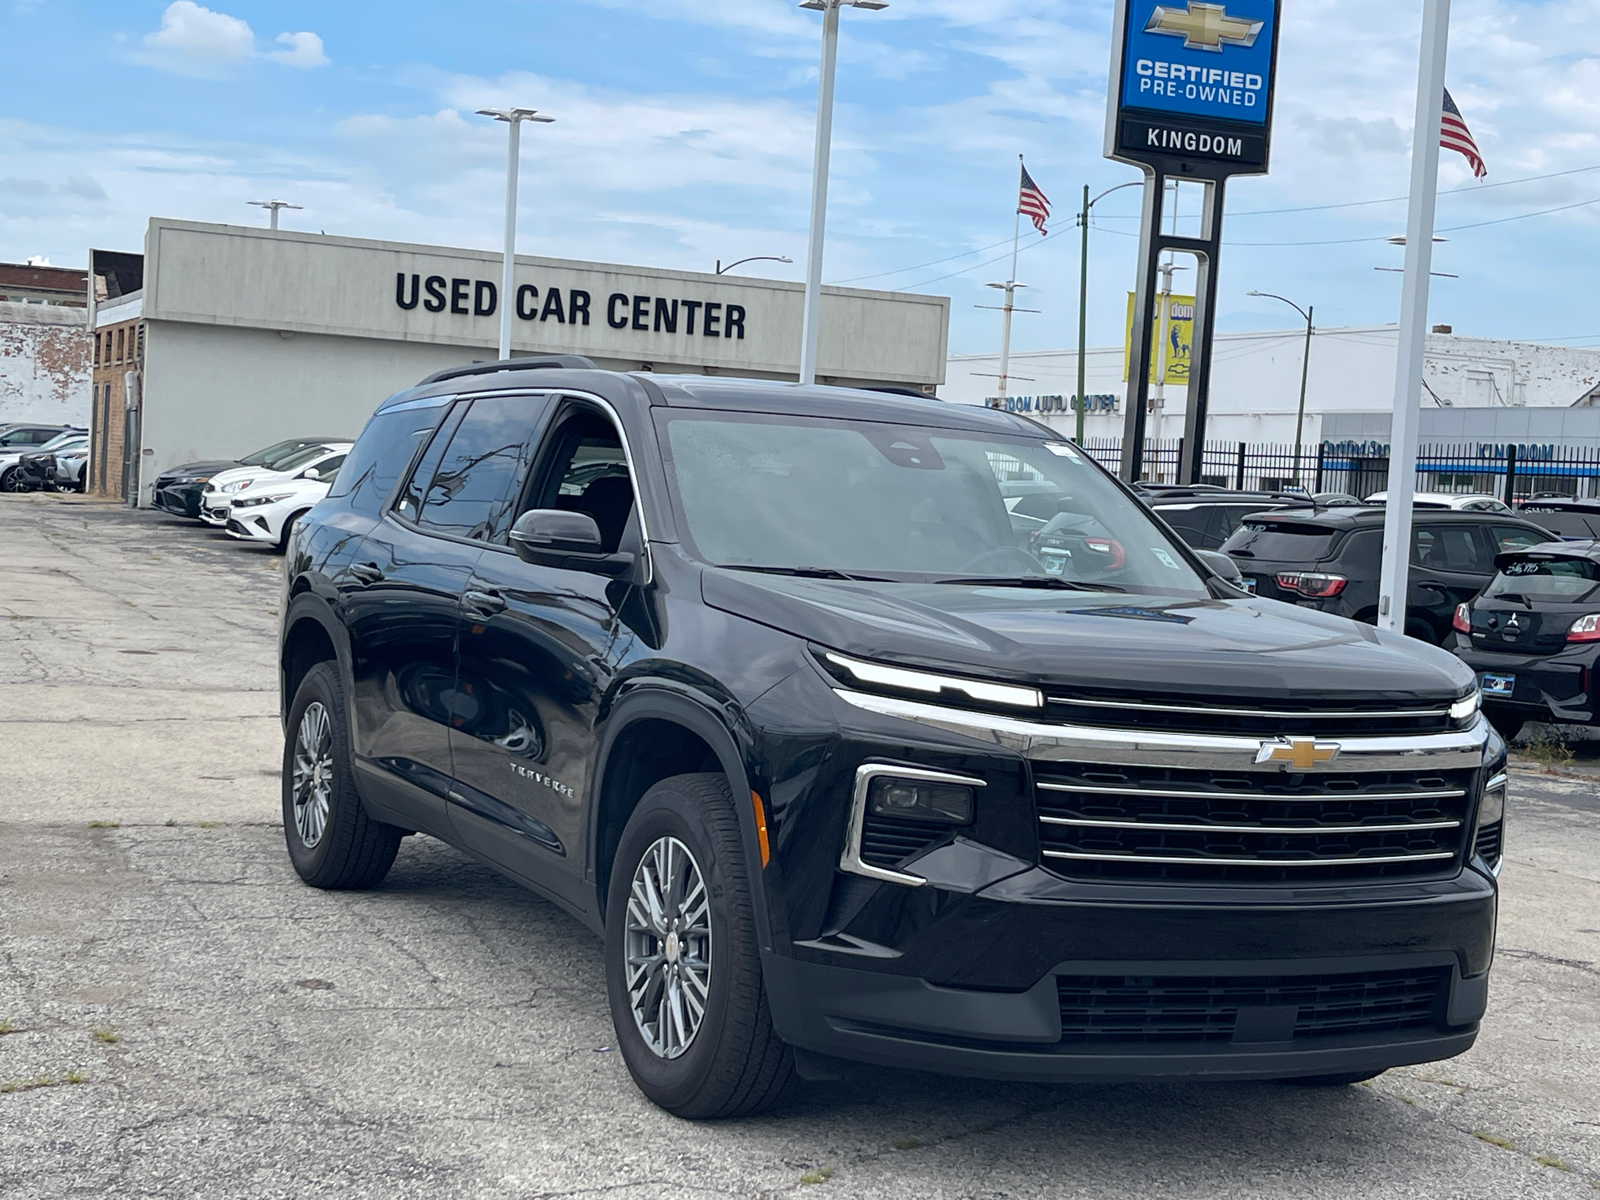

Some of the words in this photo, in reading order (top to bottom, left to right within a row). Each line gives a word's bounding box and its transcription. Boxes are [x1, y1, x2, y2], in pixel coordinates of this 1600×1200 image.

[1136, 59, 1262, 90] CERTIFIED
[1140, 78, 1256, 107] PRE-OWNED
[1147, 128, 1242, 156] KINGDOM
[395, 272, 498, 317] USED
[516, 284, 591, 326] CAR
[607, 293, 746, 339] CENTER
[1071, 394, 1119, 411] CNTER
[509, 762, 574, 798] TRAVERSE
